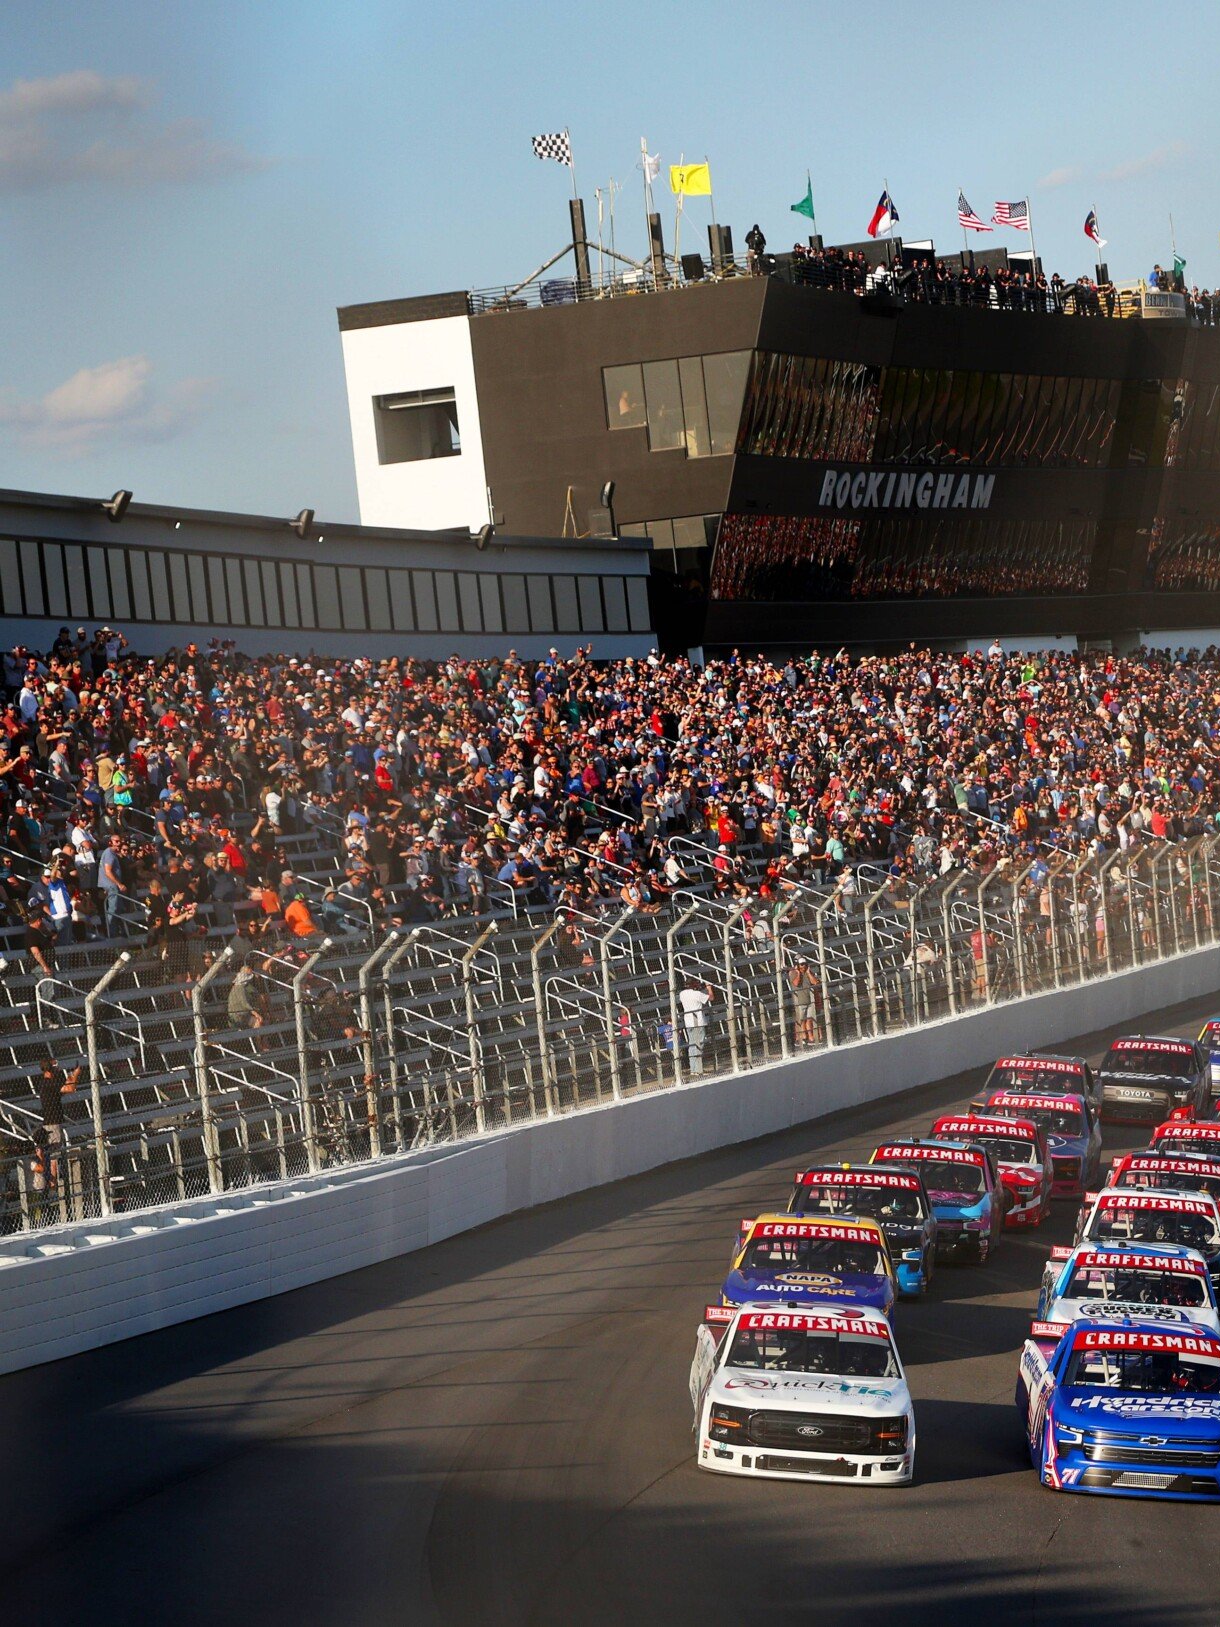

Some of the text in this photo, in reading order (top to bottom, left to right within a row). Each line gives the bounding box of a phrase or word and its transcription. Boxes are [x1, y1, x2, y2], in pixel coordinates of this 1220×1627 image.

[818, 469, 996, 509] ROCKINGHAM
[1117, 1041, 1188, 1053] CRAFTSMAN
[1001, 1059, 1074, 1073] CRAFTSMAN
[1119, 1089, 1151, 1098] TOYOTA
[994, 1096, 1074, 1111] CRAFTSMAN
[941, 1122, 1029, 1138] CRAFTSMAN
[883, 1147, 974, 1163] CRAFTSMAN
[812, 1172, 910, 1187] CRAFTSMAN
[1107, 1196, 1207, 1213] CRAFTSMAN
[762, 1224, 870, 1242] CRAFTSMAN
[1085, 1253, 1196, 1272] CRAFTSMAN
[786, 1274, 832, 1283] NAPA
[755, 1284, 857, 1296] AUTO CARE
[708, 1308, 724, 1317] THE
[749, 1314, 880, 1335] CRAFTSMAN
[1033, 1322, 1064, 1333] THE TRIP
[1085, 1332, 1213, 1353] CRAFTSMAN
[800, 1427, 820, 1437] Ford
[1061, 1468, 1081, 1484] 71
